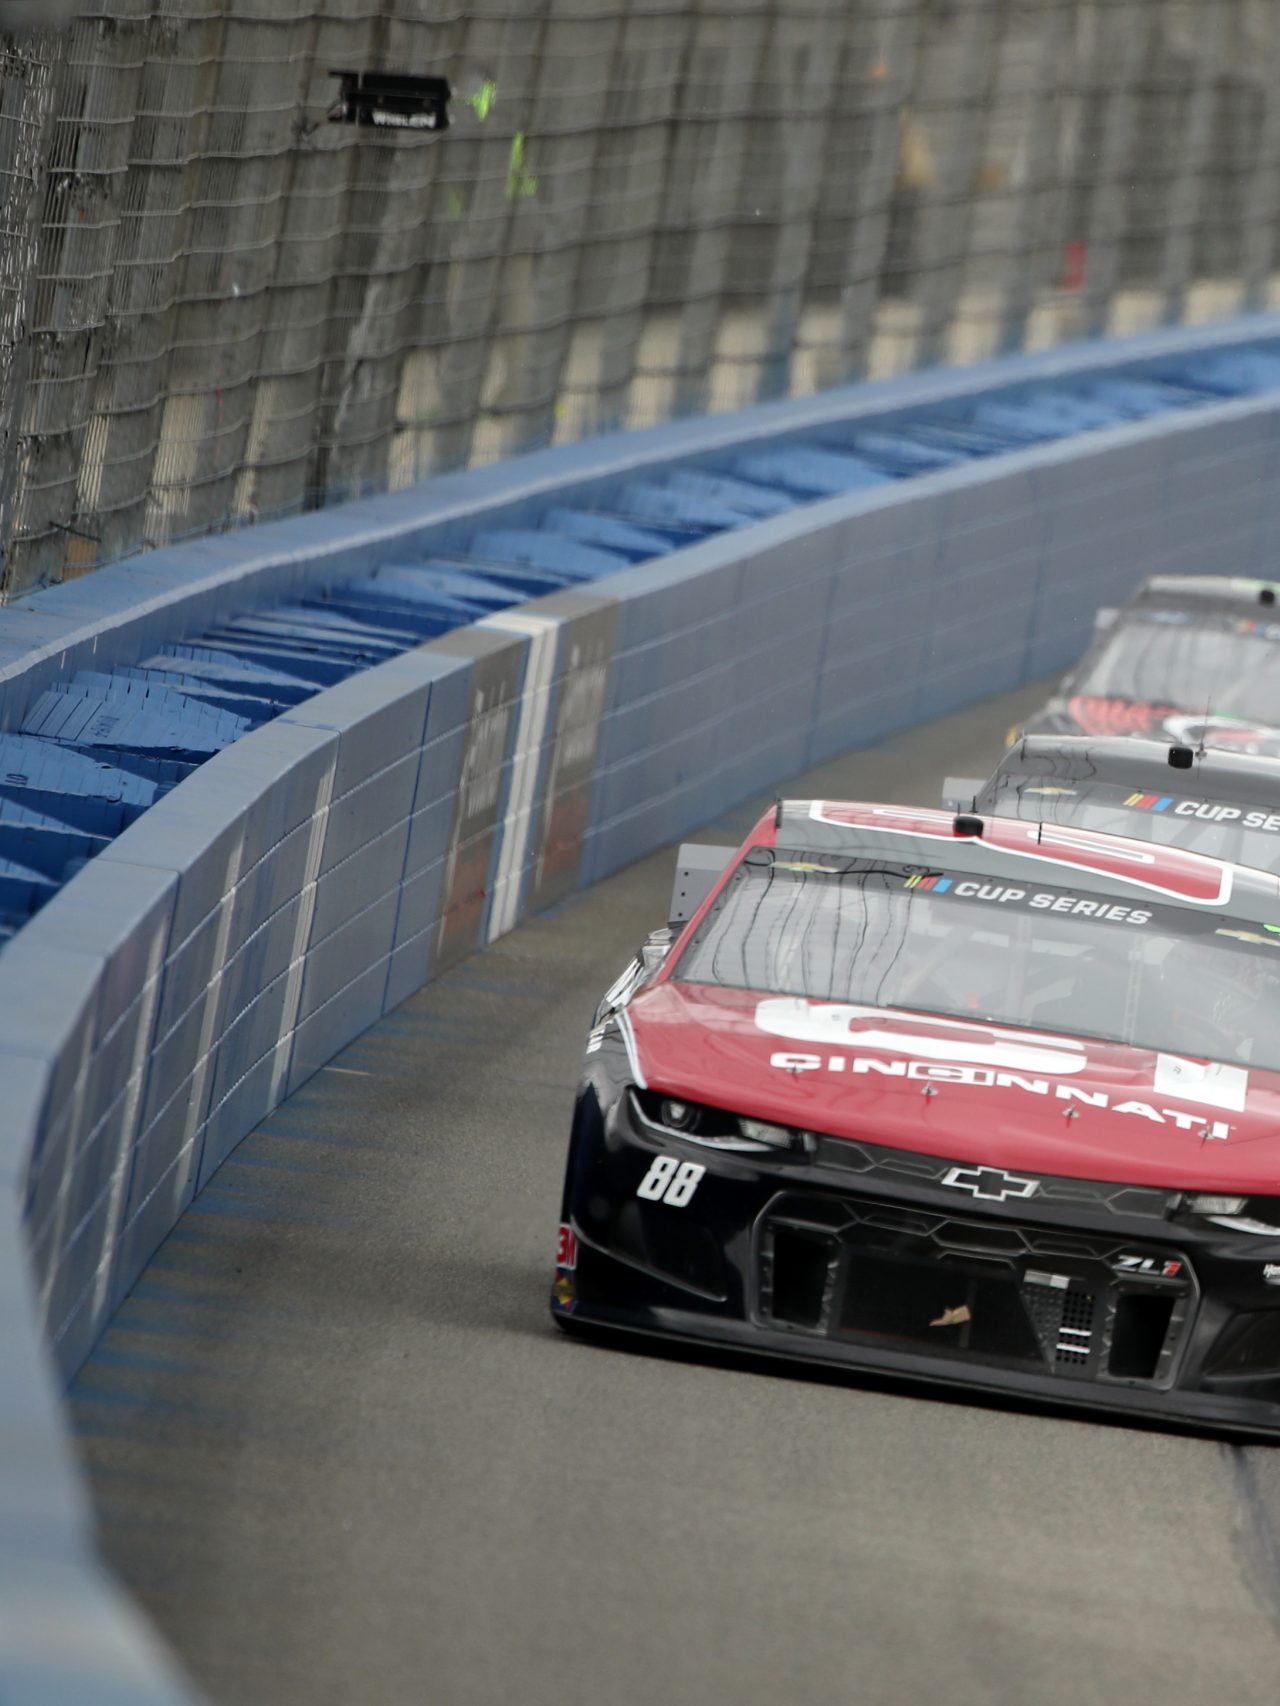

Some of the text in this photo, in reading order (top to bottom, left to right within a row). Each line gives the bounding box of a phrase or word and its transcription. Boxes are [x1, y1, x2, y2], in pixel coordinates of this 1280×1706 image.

[1175, 801, 1239, 822] CUP
[953, 881, 1153, 924] CUP SERIES
[636, 1155, 706, 1207] 88
[1112, 1255, 1182, 1277] ZL1
